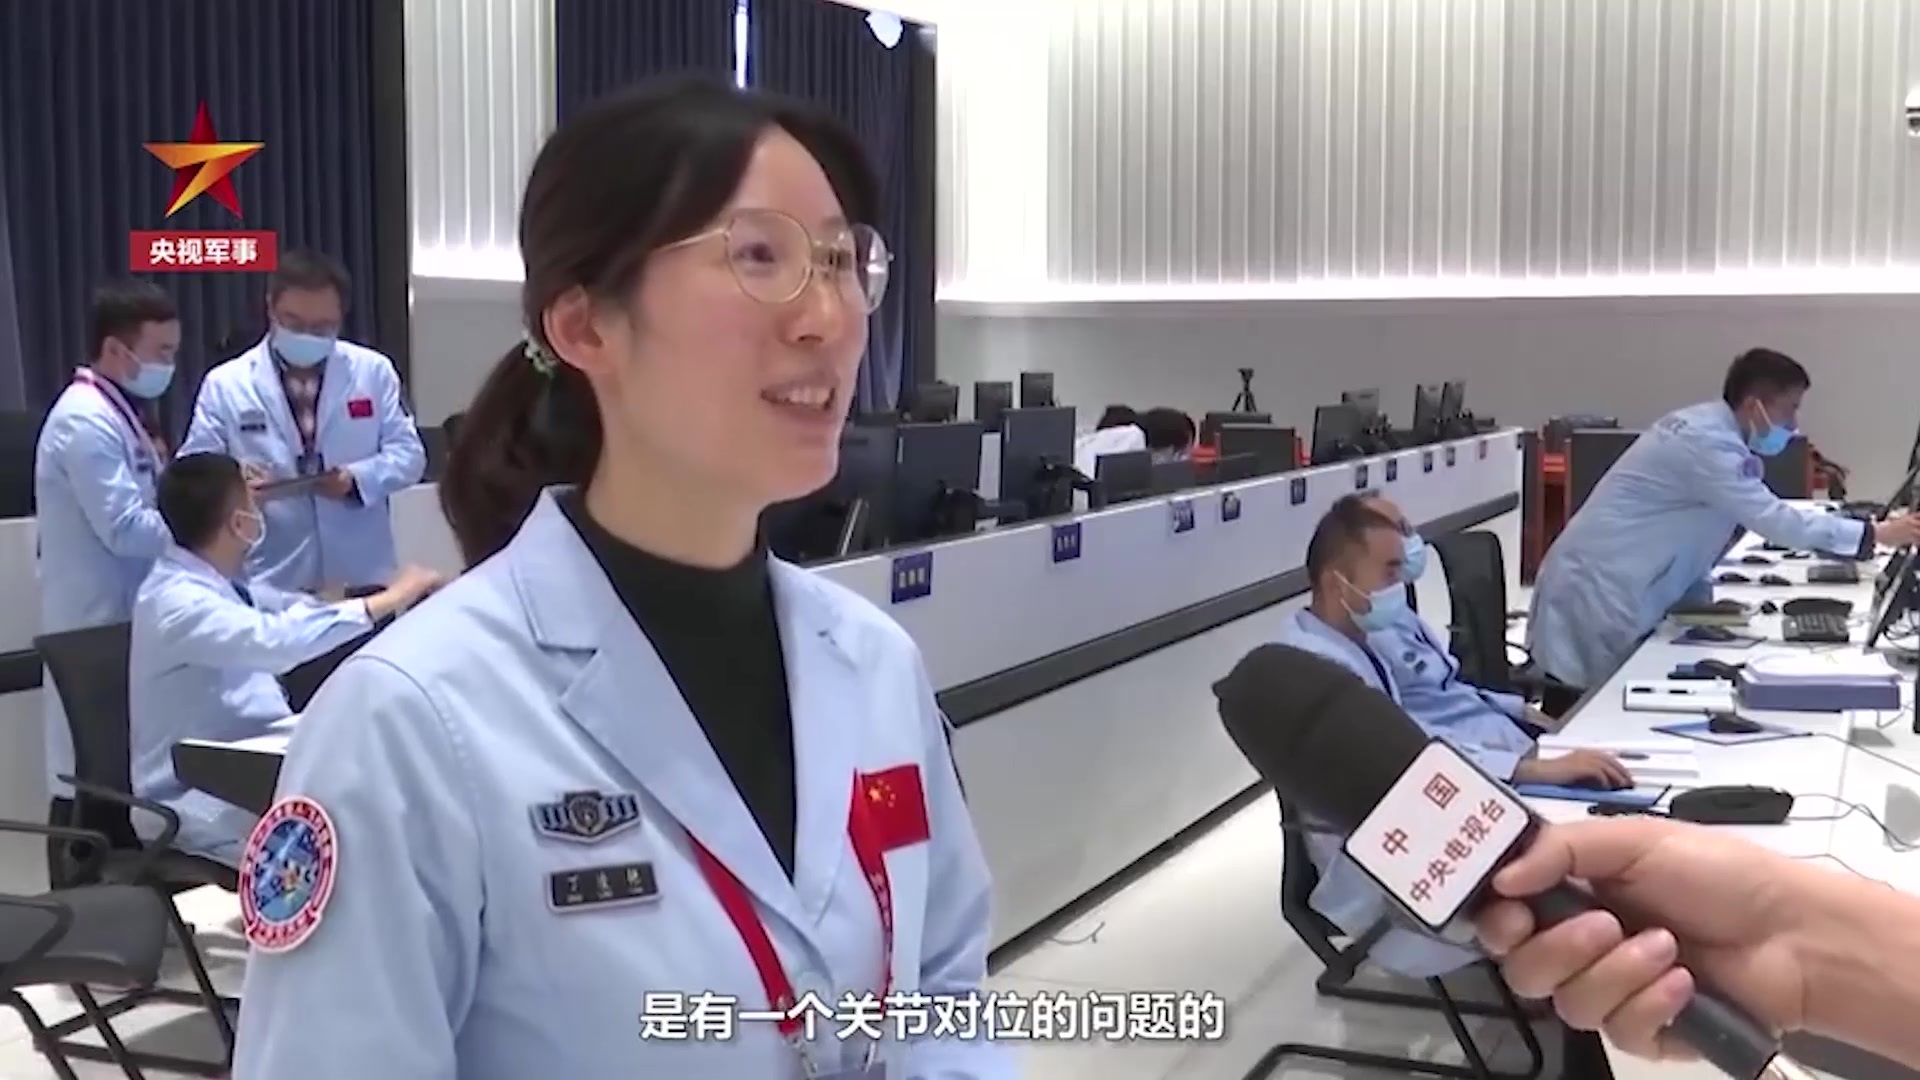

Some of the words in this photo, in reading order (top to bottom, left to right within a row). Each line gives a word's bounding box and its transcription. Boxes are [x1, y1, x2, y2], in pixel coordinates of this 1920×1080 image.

[1410, 799, 1505, 902] 中央电视台
